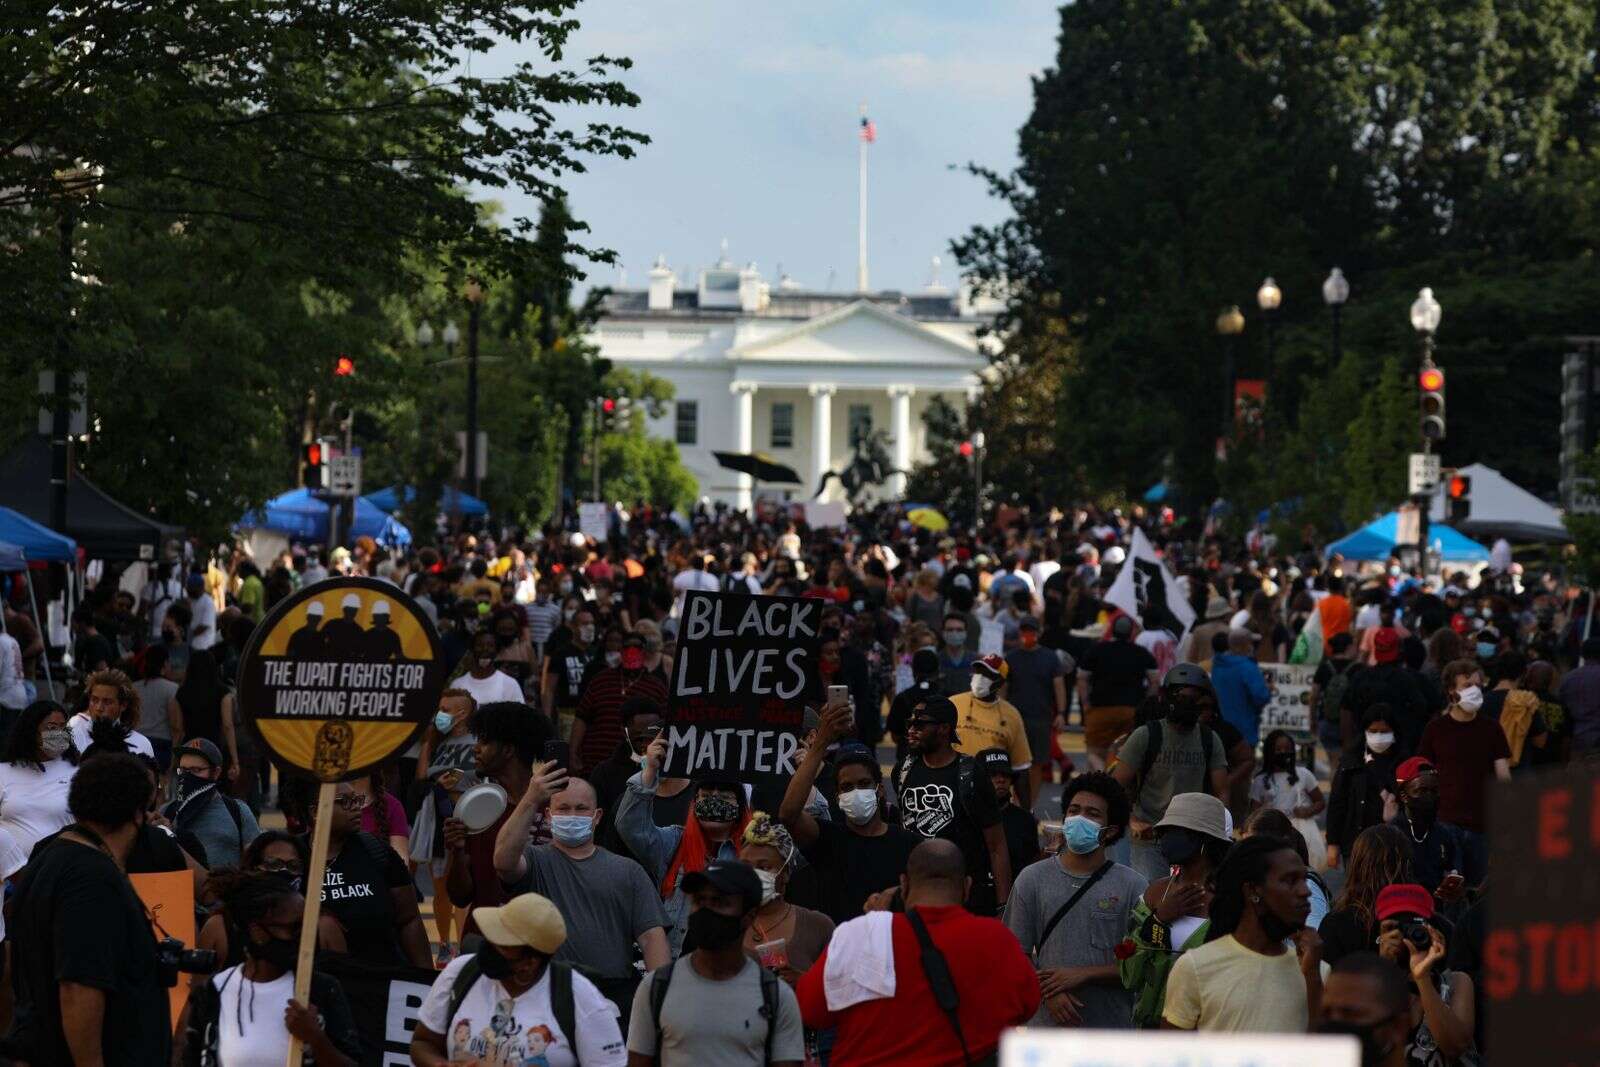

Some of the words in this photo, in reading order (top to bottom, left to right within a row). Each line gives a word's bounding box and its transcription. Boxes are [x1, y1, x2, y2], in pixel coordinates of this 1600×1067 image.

[687, 596, 815, 641] BLACK
[264, 661, 294, 686] THE
[295, 662, 338, 687] IUPAT
[339, 663, 392, 689] FIGHTS
[394, 664, 425, 689] FOR
[676, 646, 808, 700] LIVES
[275, 690, 347, 716] WORKING
[348, 691, 406, 717] PEOPLE
[663, 725, 798, 775] MATTER
[321, 872, 345, 886] LIZE
[331, 883, 374, 899] BLACK
[1483, 920, 1600, 1000] STO
